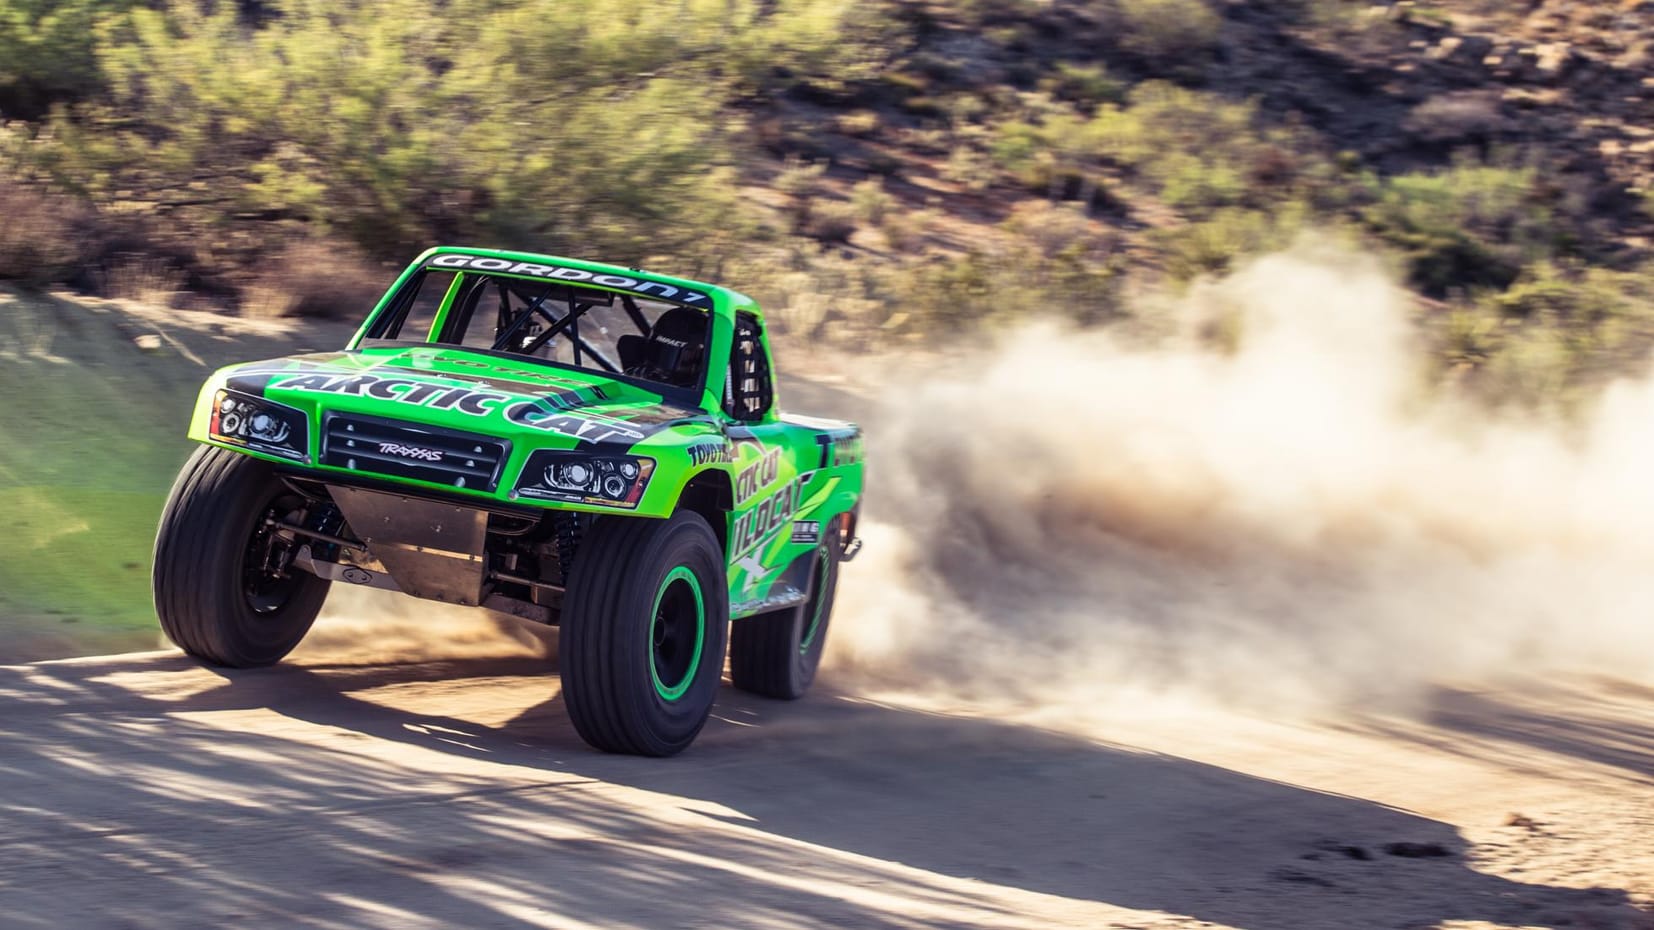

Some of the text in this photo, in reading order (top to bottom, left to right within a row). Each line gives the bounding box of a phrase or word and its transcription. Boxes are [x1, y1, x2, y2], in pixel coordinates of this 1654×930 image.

[432, 255, 679, 298] GORDON
[656, 335, 687, 348] IMPACT
[281, 375, 626, 444] ARCTIC CAT
[379, 442, 443, 461] TRAXXAS
[687, 443, 717, 467] TOYO
[736, 461, 760, 505] CTIC
[732, 469, 816, 558] ILDCAT
